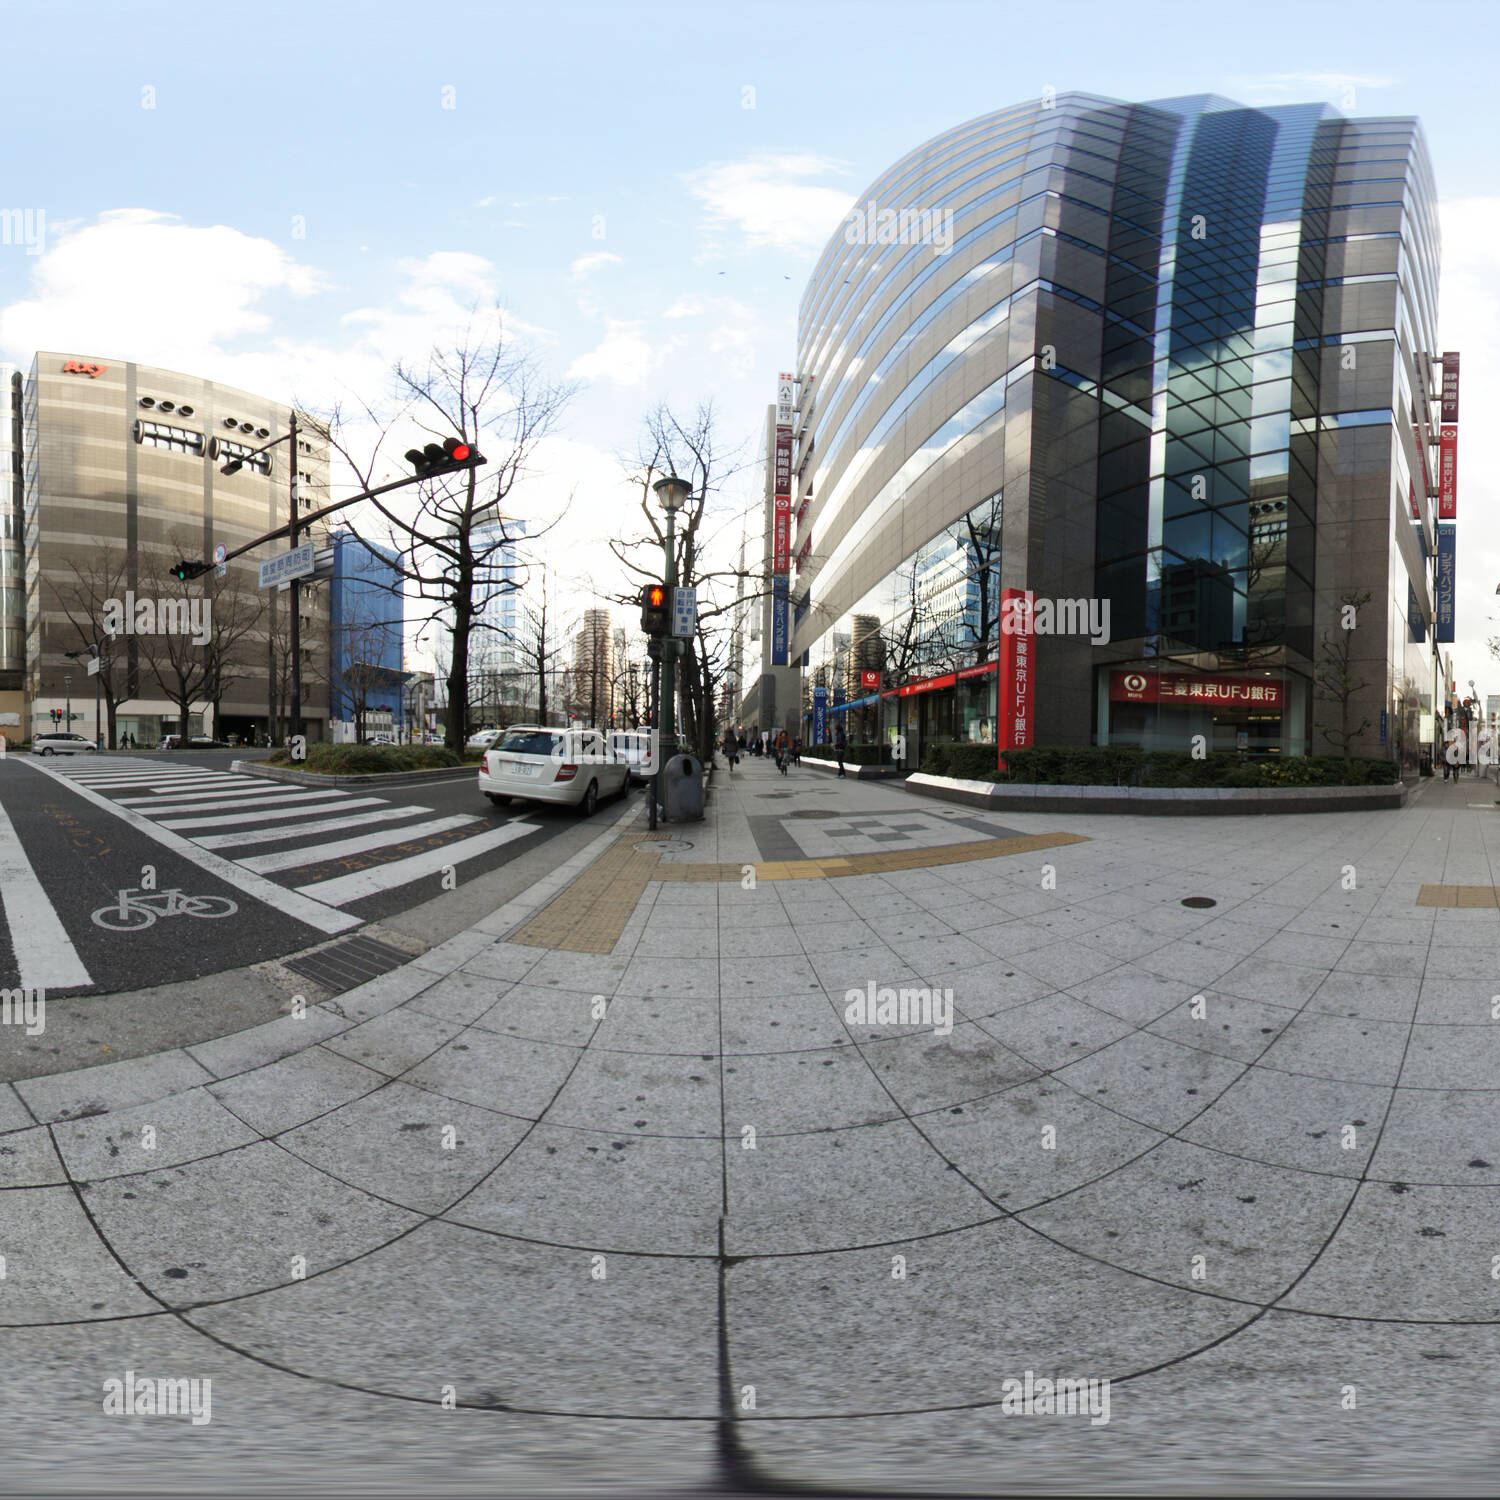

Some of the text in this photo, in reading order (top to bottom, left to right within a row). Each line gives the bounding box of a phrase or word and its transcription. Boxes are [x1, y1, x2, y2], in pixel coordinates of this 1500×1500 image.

[1443, 373, 1457, 410] 静岡銀行
[777, 448, 789, 486] 静岡銀行
[1014, 628, 1027, 745] 三菱東京UFJ銀行
[1160, 681, 1277, 701] 三菱東京UFJ銀行
